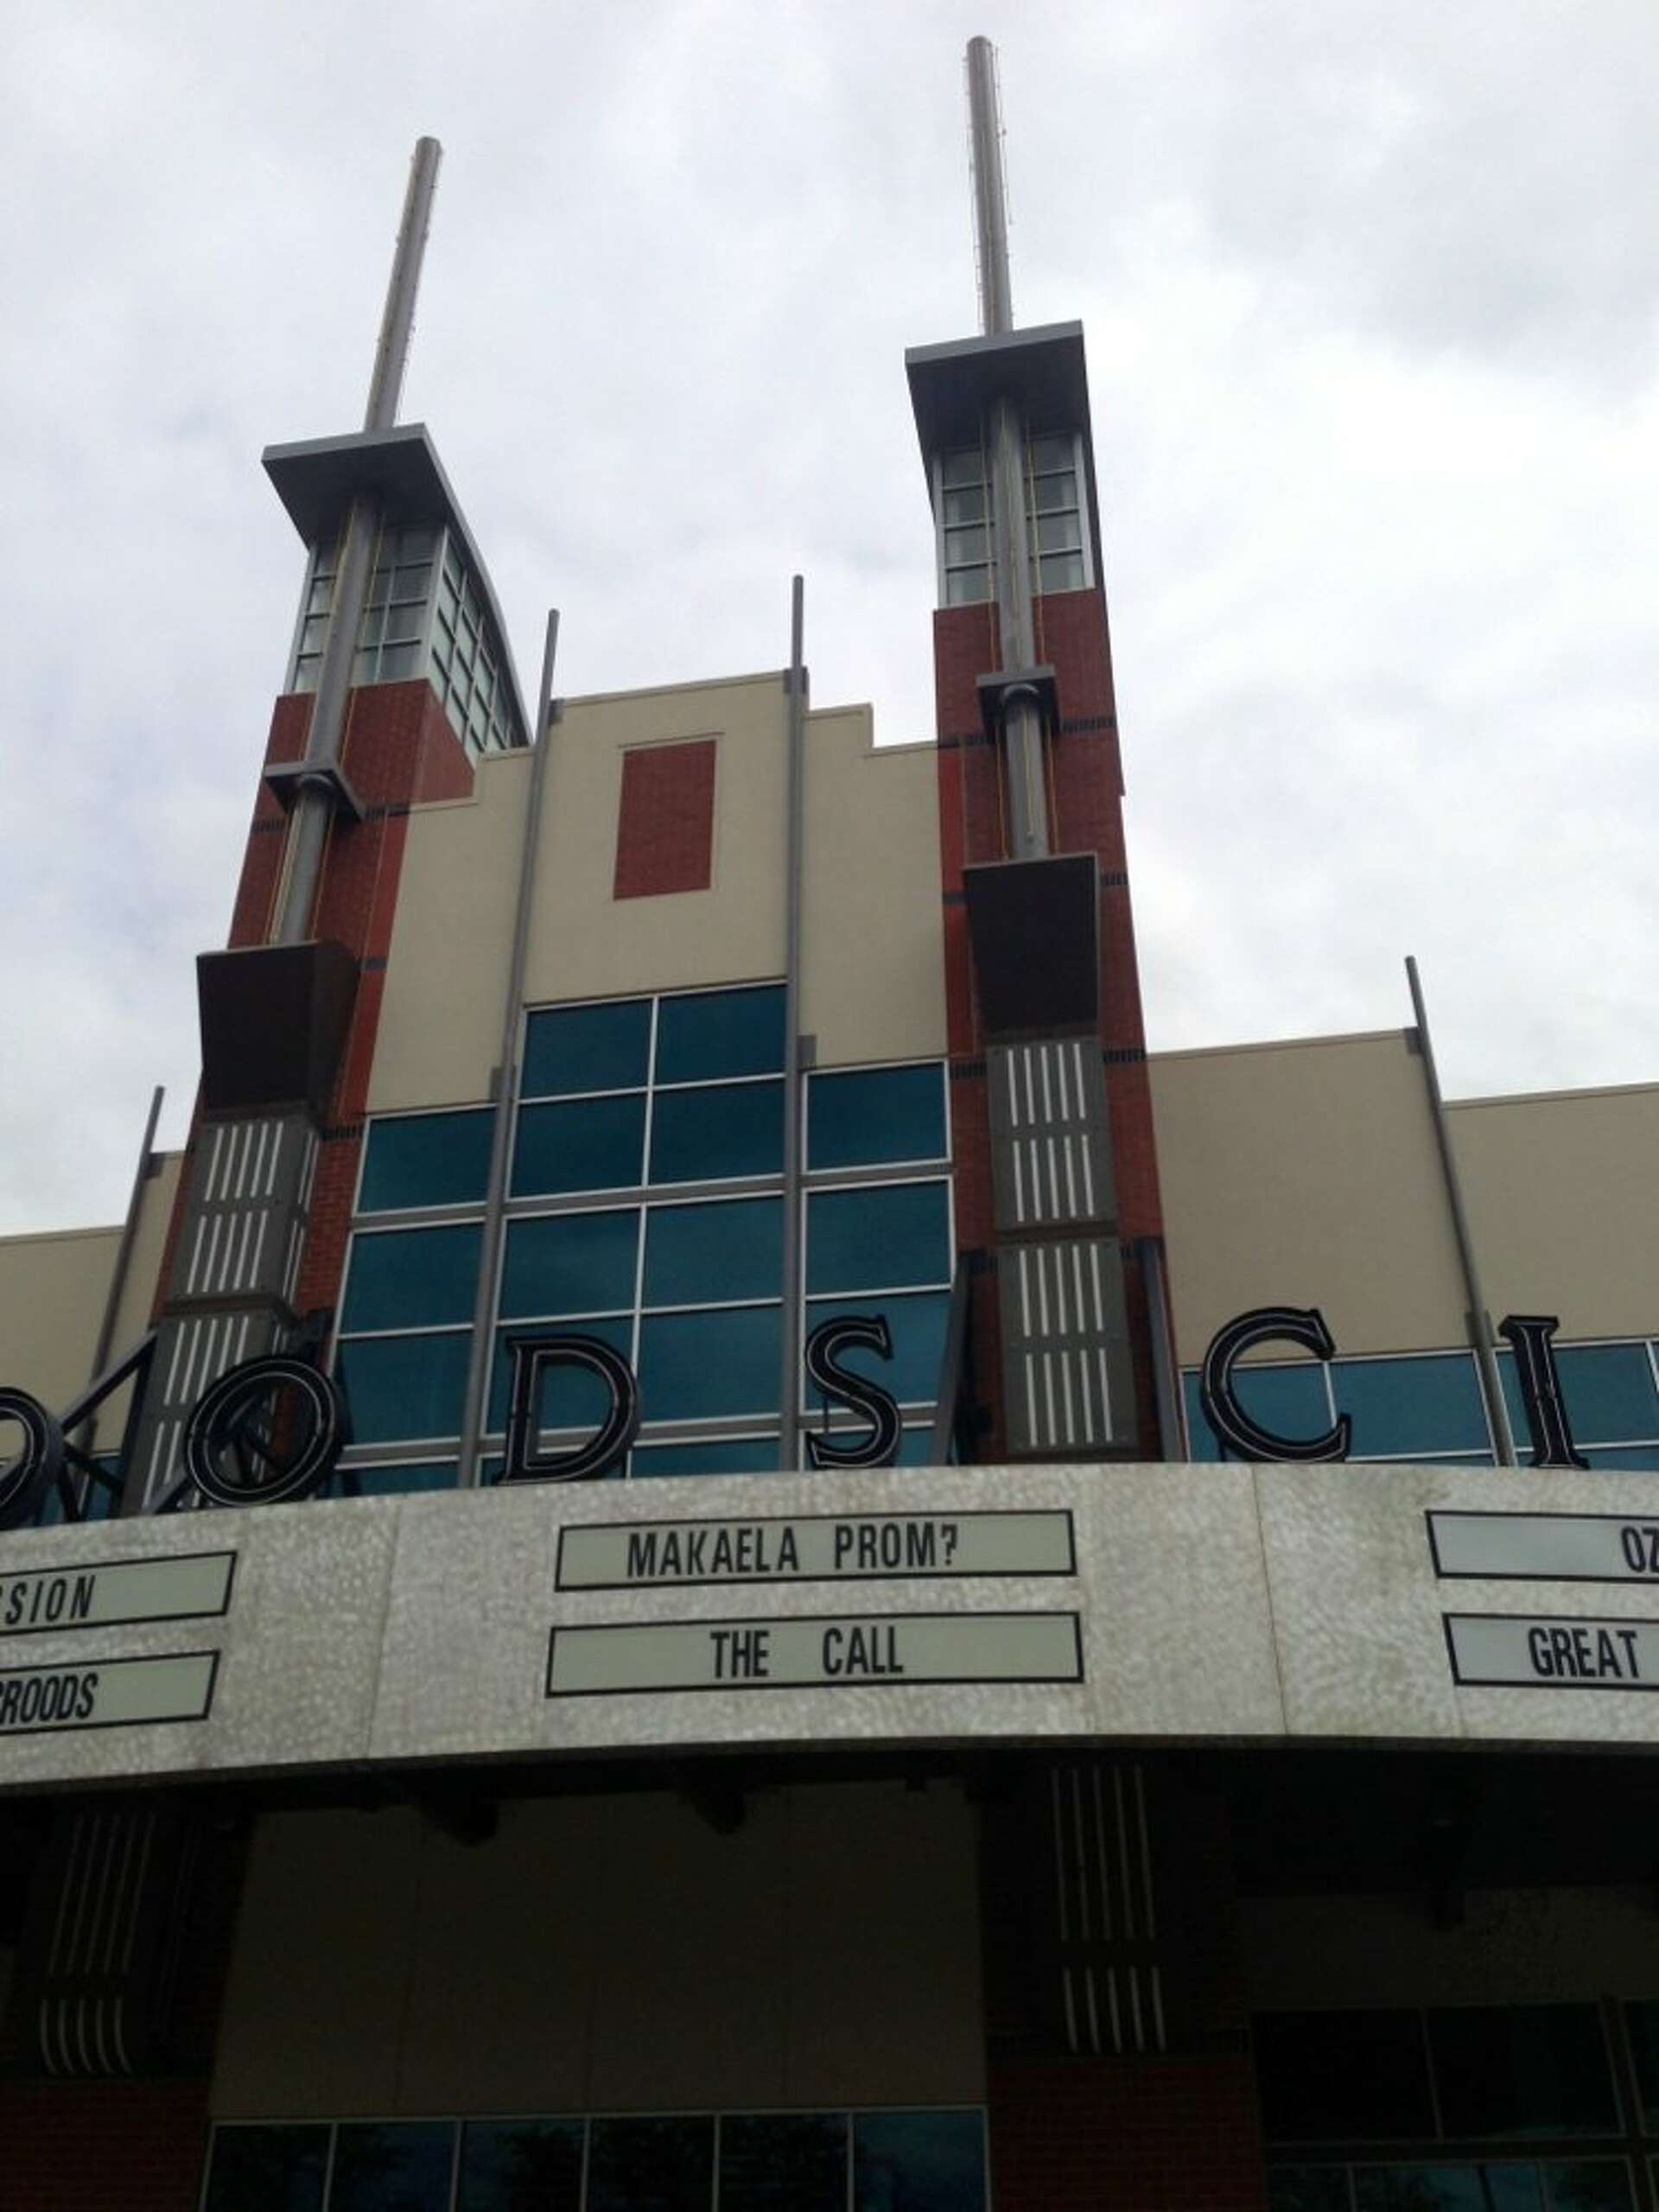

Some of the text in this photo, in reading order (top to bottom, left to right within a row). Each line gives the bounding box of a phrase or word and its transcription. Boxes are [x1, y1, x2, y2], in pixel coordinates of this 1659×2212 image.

[627, 1522, 958, 1579] MAKAELA PROM?
[0, 1575, 95, 1624] SION
[709, 1626, 904, 1679] THE CALL
[1528, 1627, 1640, 1678] GREAT
[0, 1673, 99, 1725] ROODS
